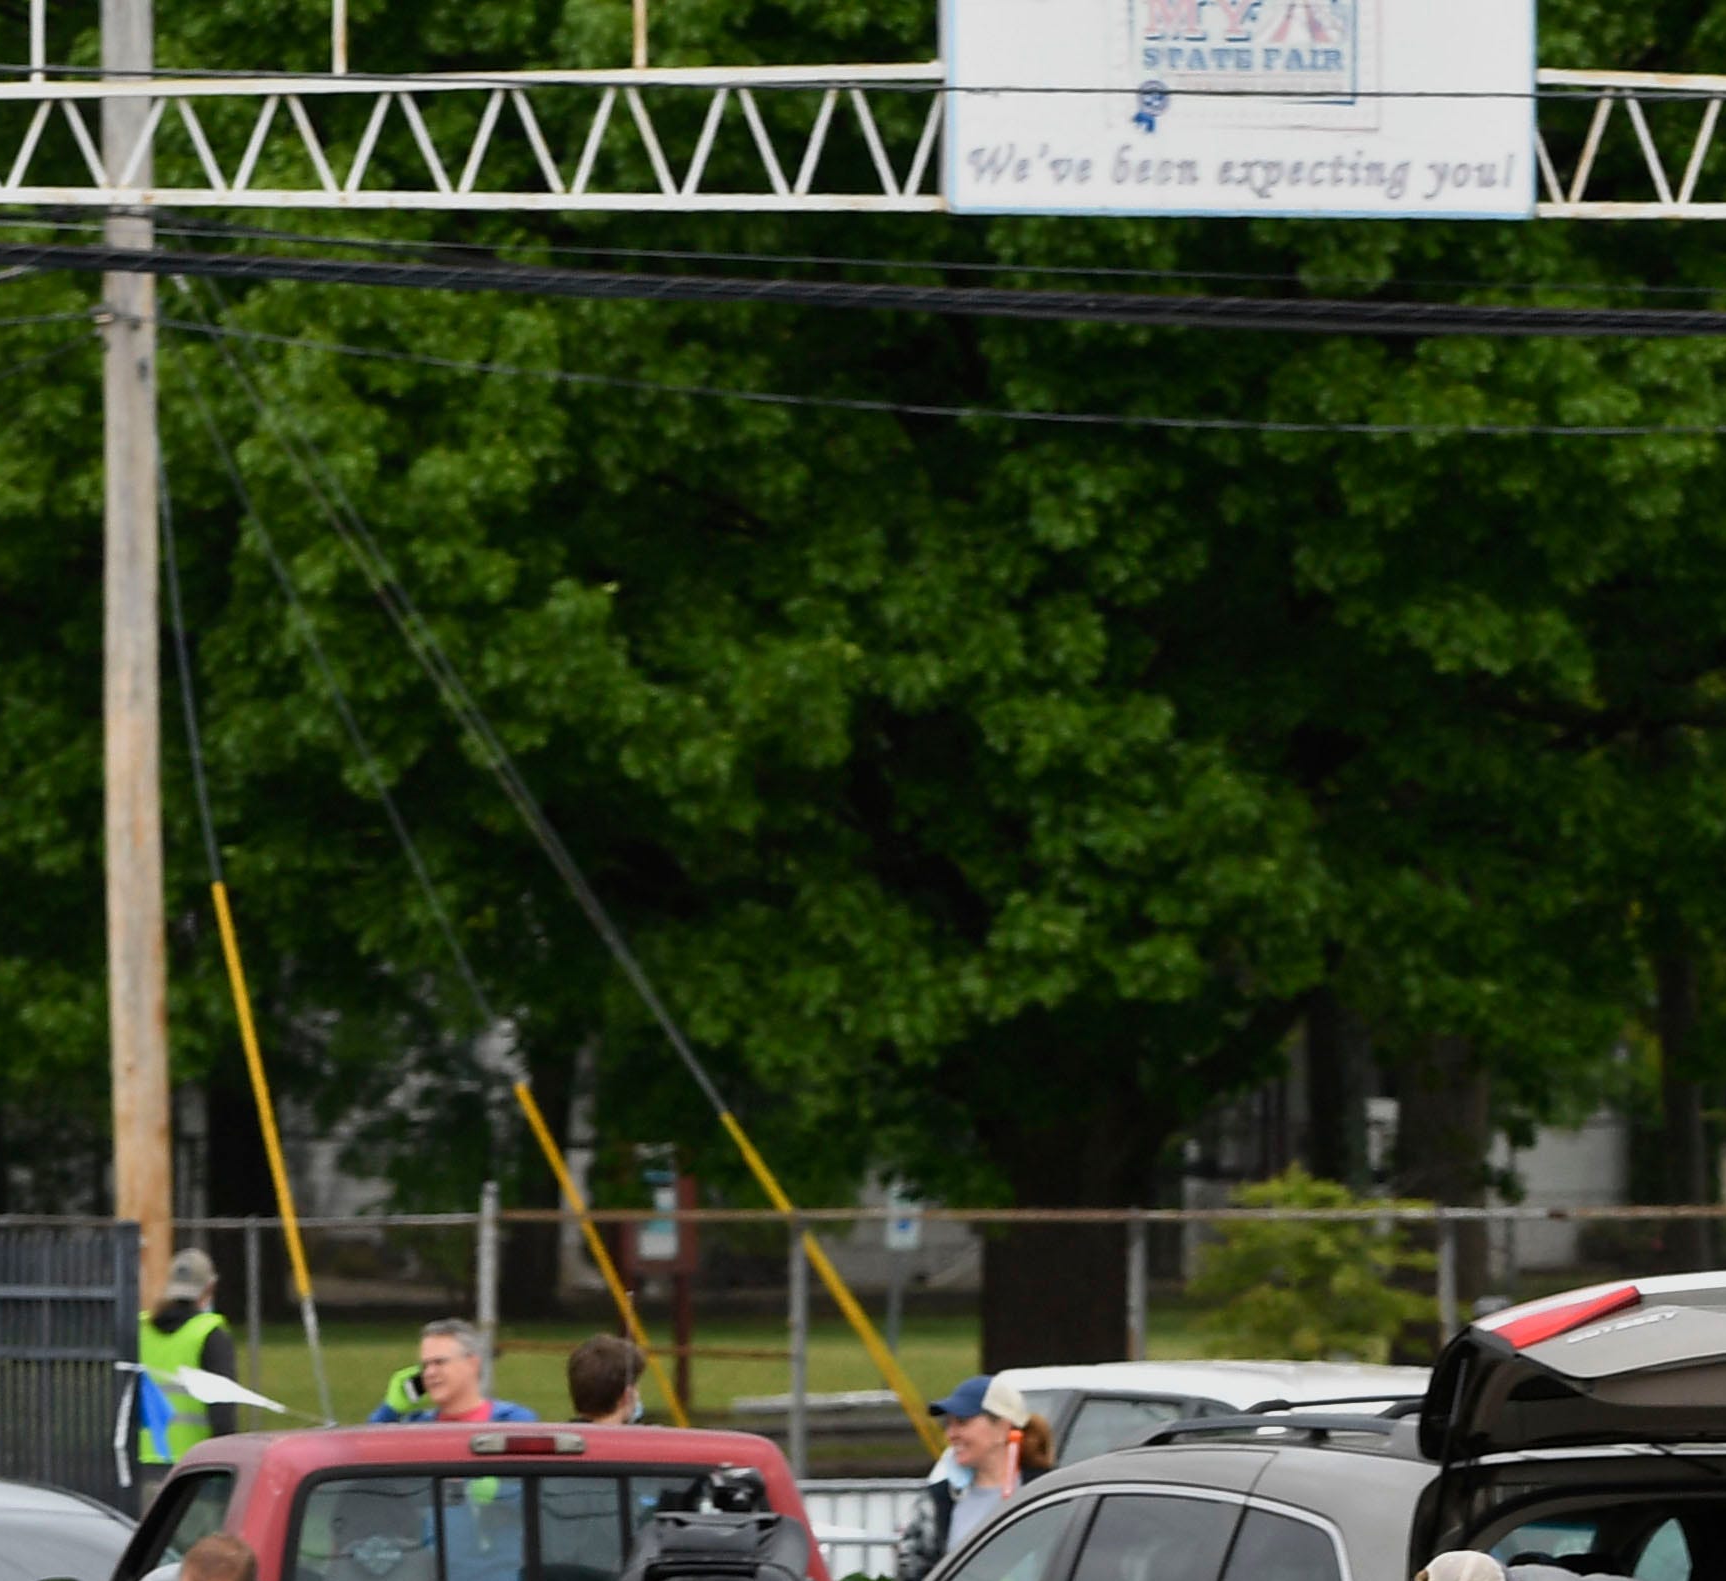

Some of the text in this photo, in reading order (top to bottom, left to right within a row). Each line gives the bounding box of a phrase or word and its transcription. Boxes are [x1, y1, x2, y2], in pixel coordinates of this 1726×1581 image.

[1142, 48, 1344, 71] STATE FAIR
[967, 142, 1518, 200] We've been expecting you!
